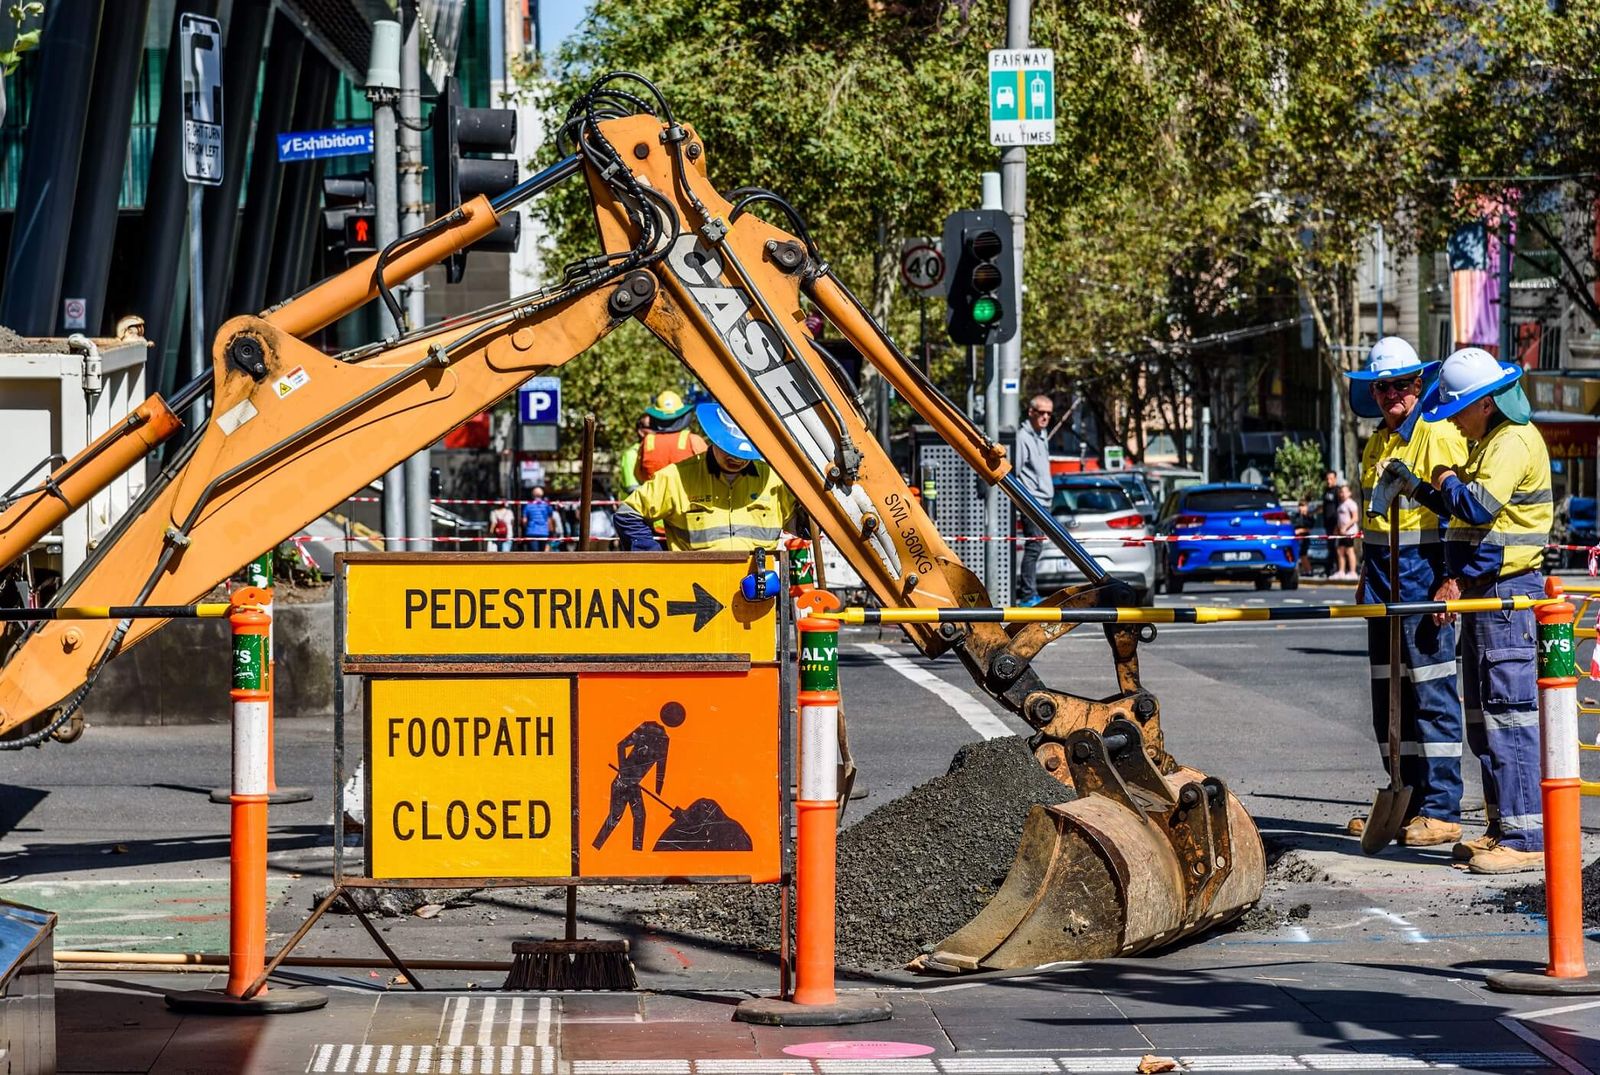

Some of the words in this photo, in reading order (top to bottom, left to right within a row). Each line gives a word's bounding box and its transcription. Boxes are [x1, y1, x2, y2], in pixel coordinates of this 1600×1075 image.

[994, 54, 1048, 67] FAIRWAY
[293, 133, 365, 152] Exhibition
[994, 132, 1015, 143] ALL
[1021, 131, 1052, 143] TIMES
[907, 256, 939, 279] 40
[668, 233, 812, 418] CASE
[529, 392, 551, 420] P
[884, 493, 908, 528] SWL
[901, 527, 933, 575] 360KG
[404, 587, 660, 630] PEDESTRIANS
[801, 647, 838, 662] ALY'
[387, 716, 554, 758] FOOTPATH
[392, 799, 552, 842] CLOSED
